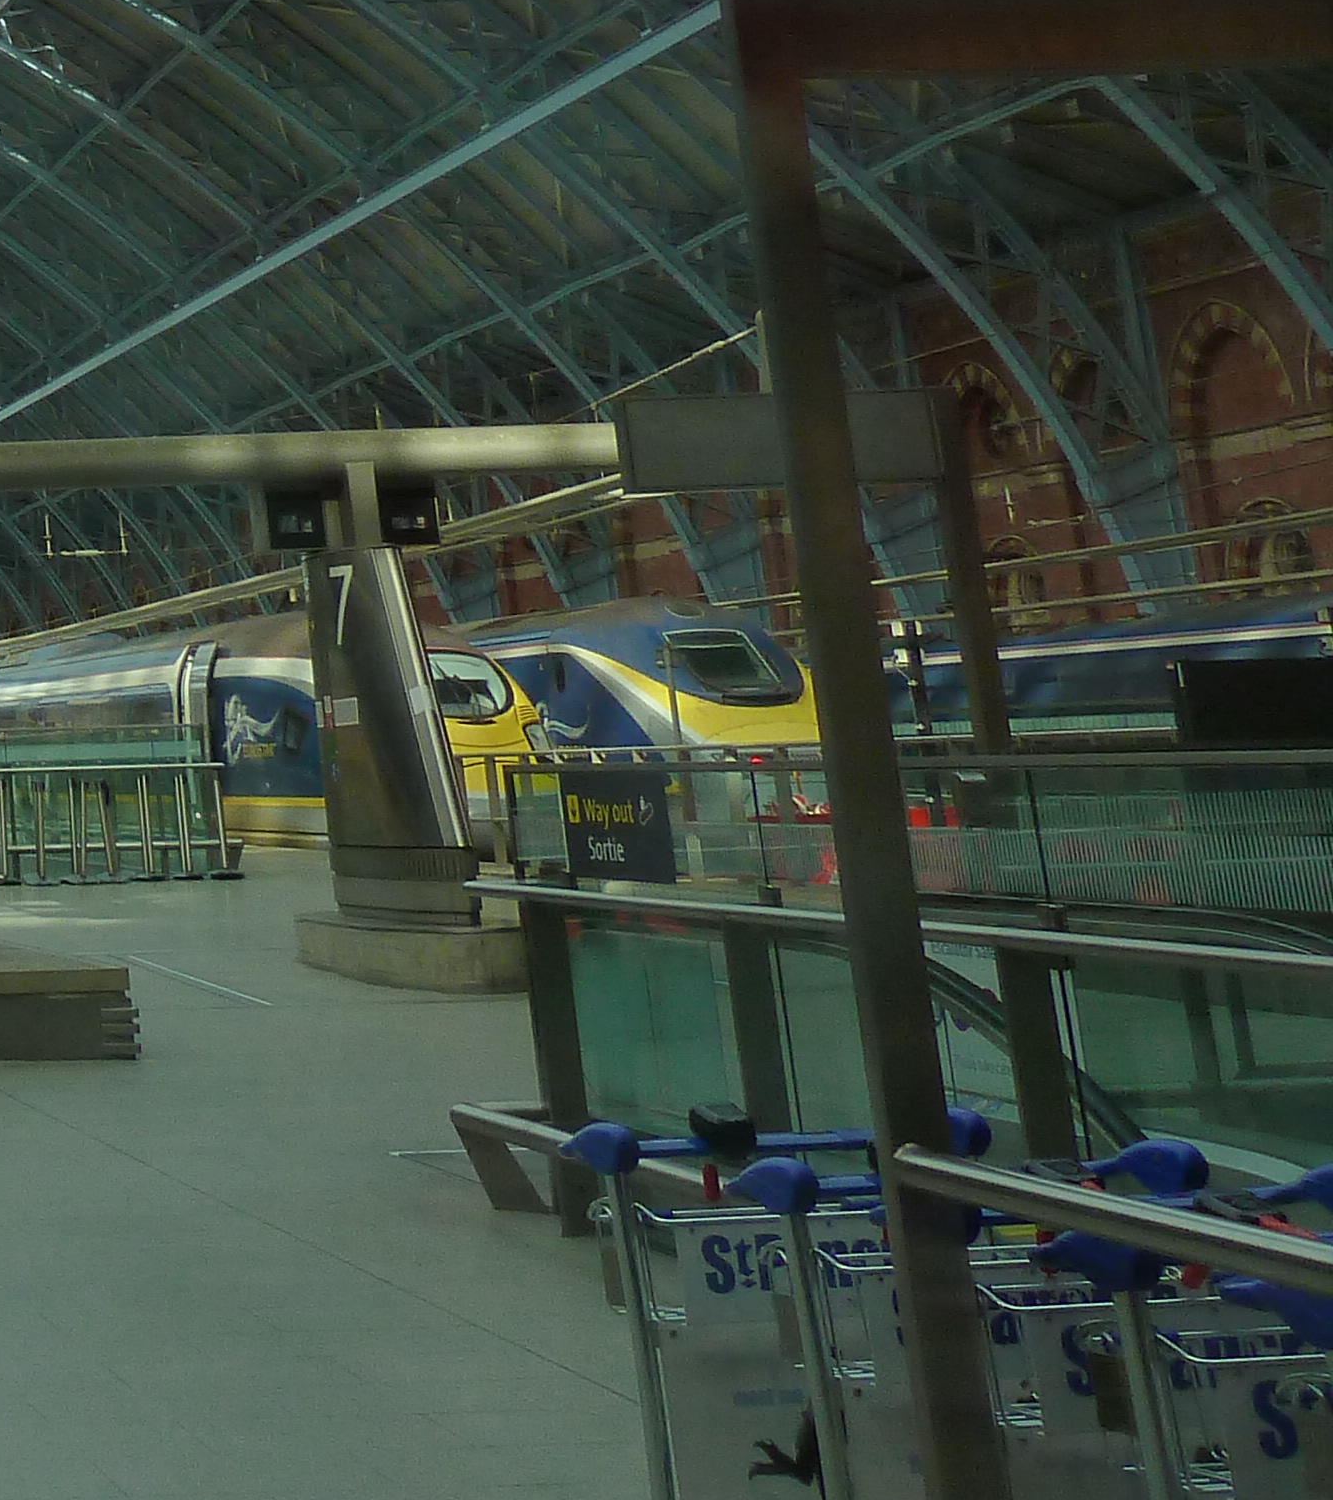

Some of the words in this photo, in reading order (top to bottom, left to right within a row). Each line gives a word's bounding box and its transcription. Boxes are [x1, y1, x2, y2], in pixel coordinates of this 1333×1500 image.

[328, 564, 353, 646] 7
[582, 798, 610, 831] Way
[612, 800, 635, 824] out
[587, 834, 626, 862] Sortie
